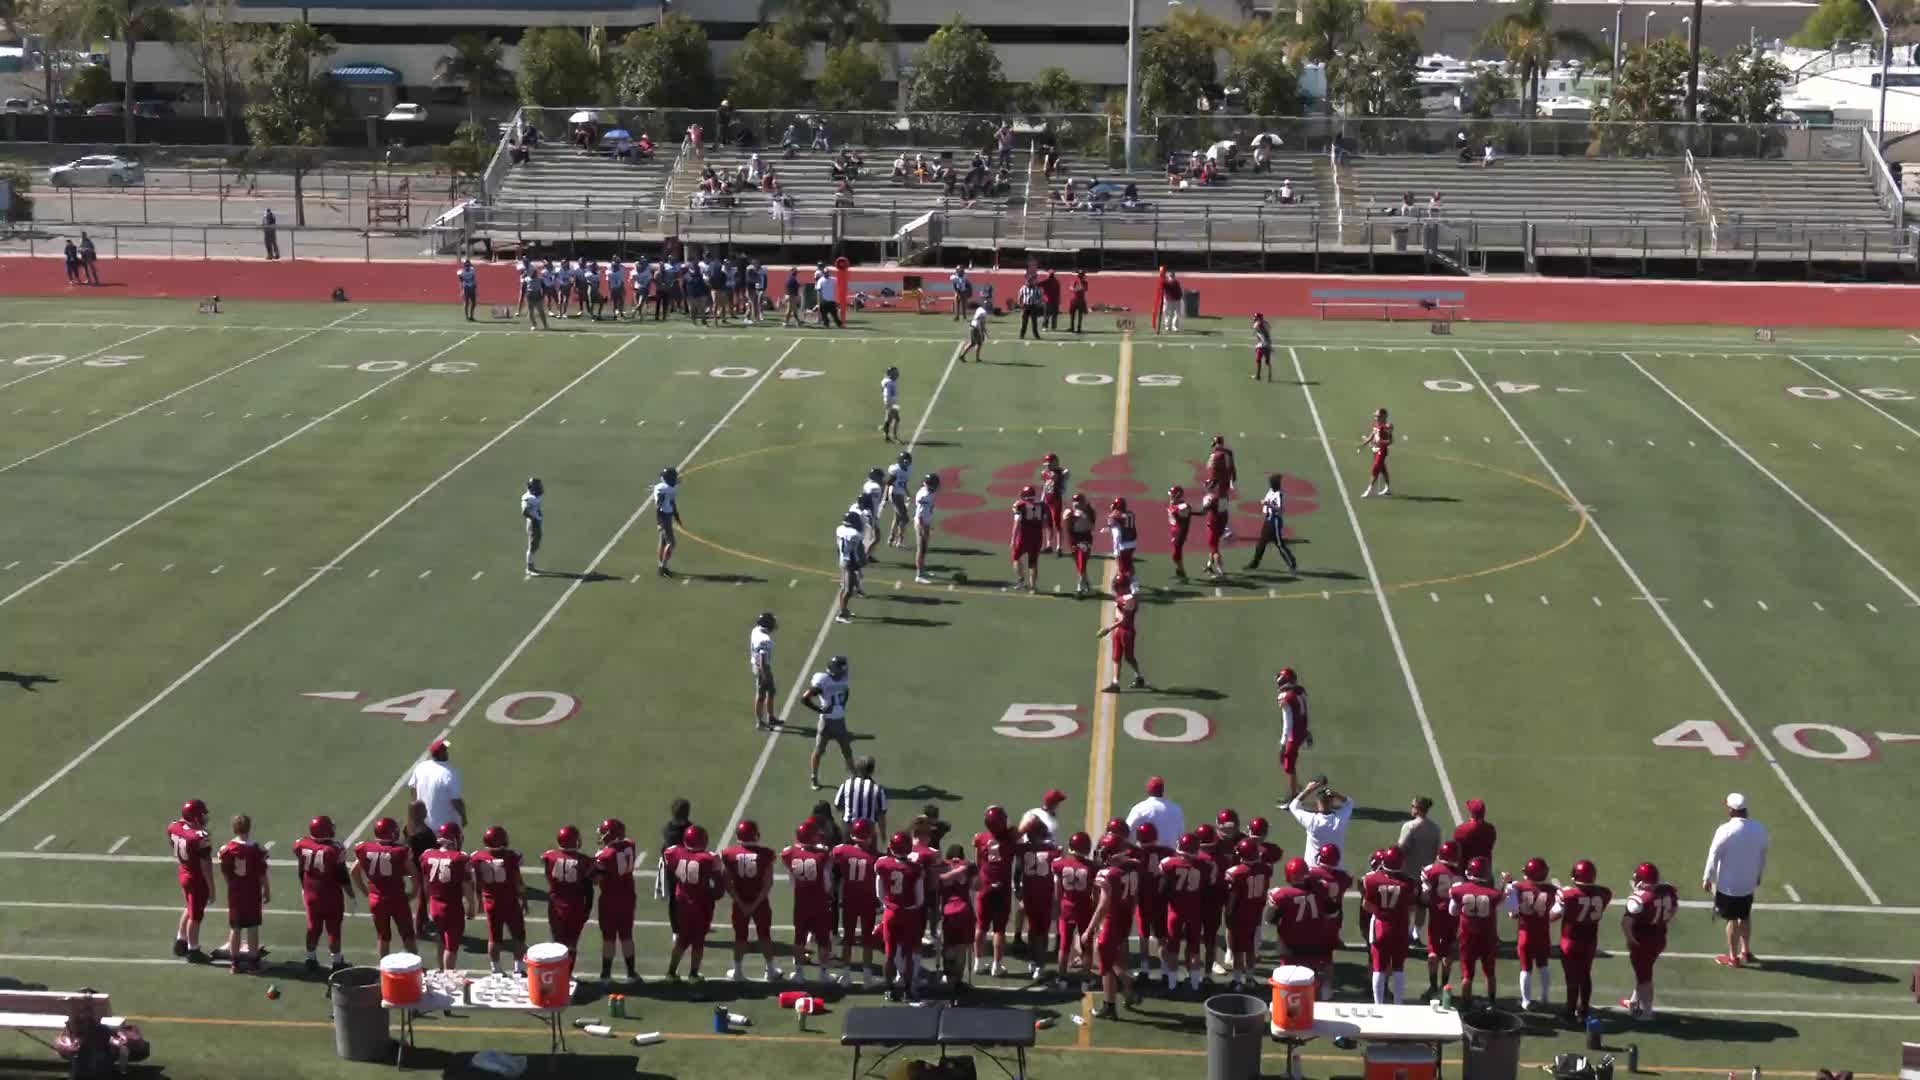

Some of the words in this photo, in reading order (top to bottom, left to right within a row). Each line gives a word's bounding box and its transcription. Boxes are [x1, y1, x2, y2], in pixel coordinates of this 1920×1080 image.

[709, 366, 826, 380] 40
[1065, 373, 1184, 387] 50
[1423, 378, 1541, 393] 40
[360, 688, 579, 726] 40
[992, 703, 1215, 743] 50
[1652, 719, 1879, 762] 40
[1378, 884, 1401, 909] 17
[541, 971, 553, 985] G
[1287, 993, 1301, 1006] G
